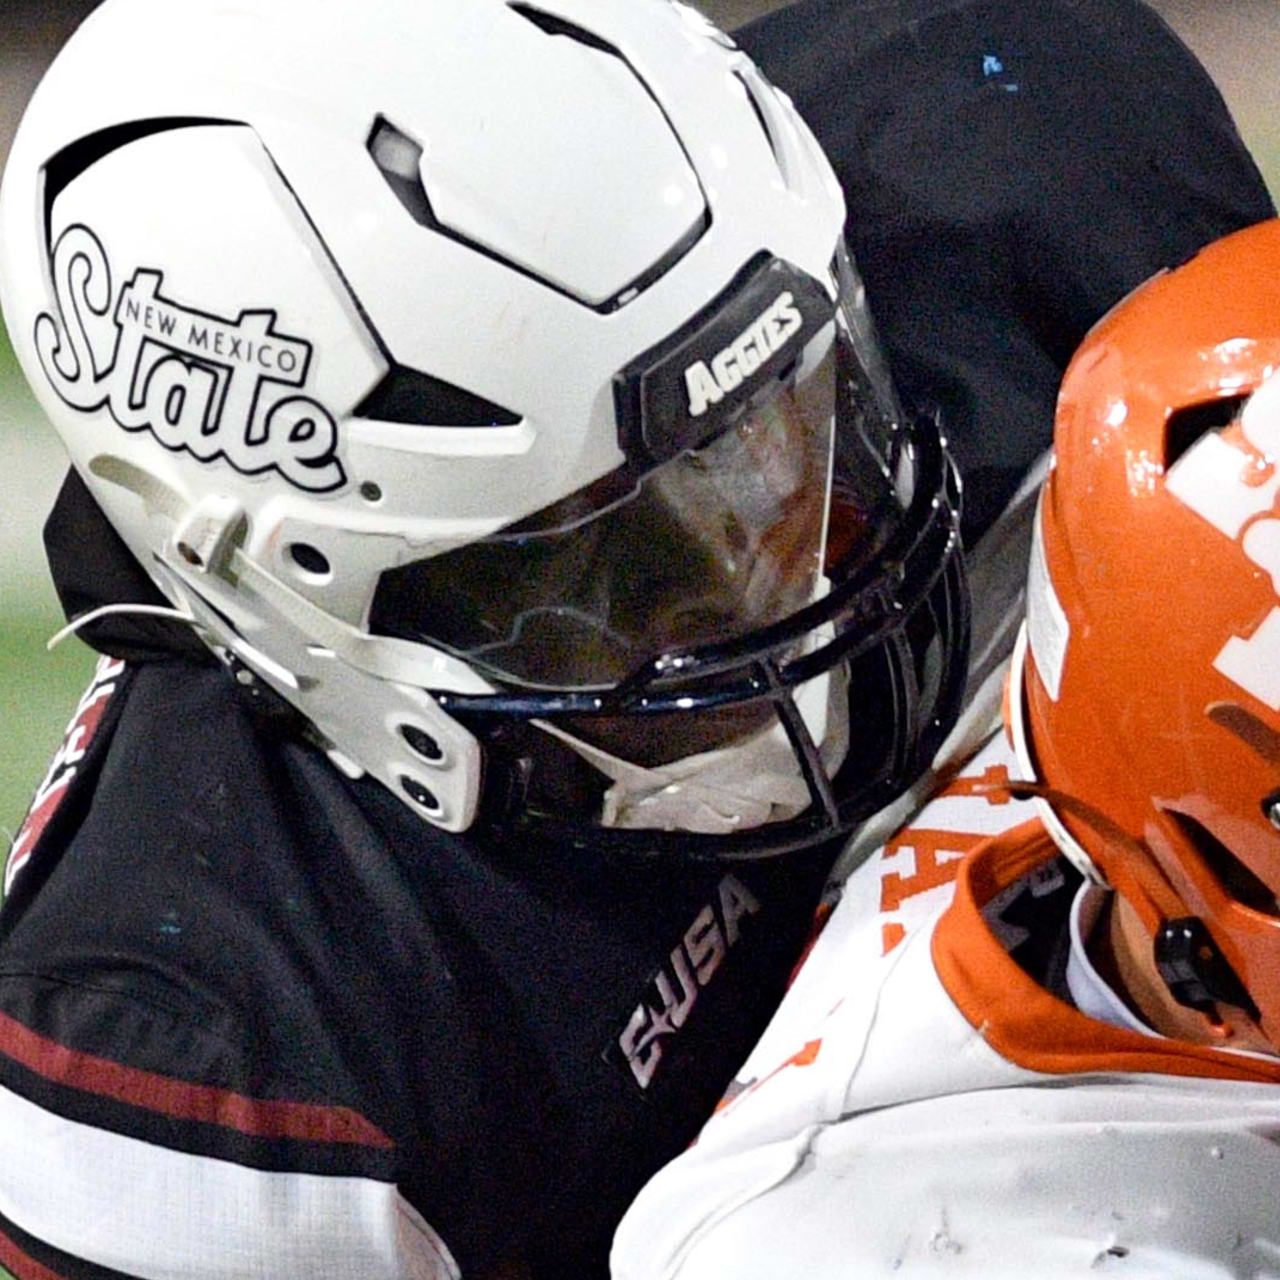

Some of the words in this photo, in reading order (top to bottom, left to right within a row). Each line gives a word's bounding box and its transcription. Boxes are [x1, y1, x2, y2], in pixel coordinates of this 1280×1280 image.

[34, 223, 347, 494] State
[126, 299, 178, 337] NEW
[187, 323, 297, 373] MEXICO
[684, 291, 802, 417] AGGIES
